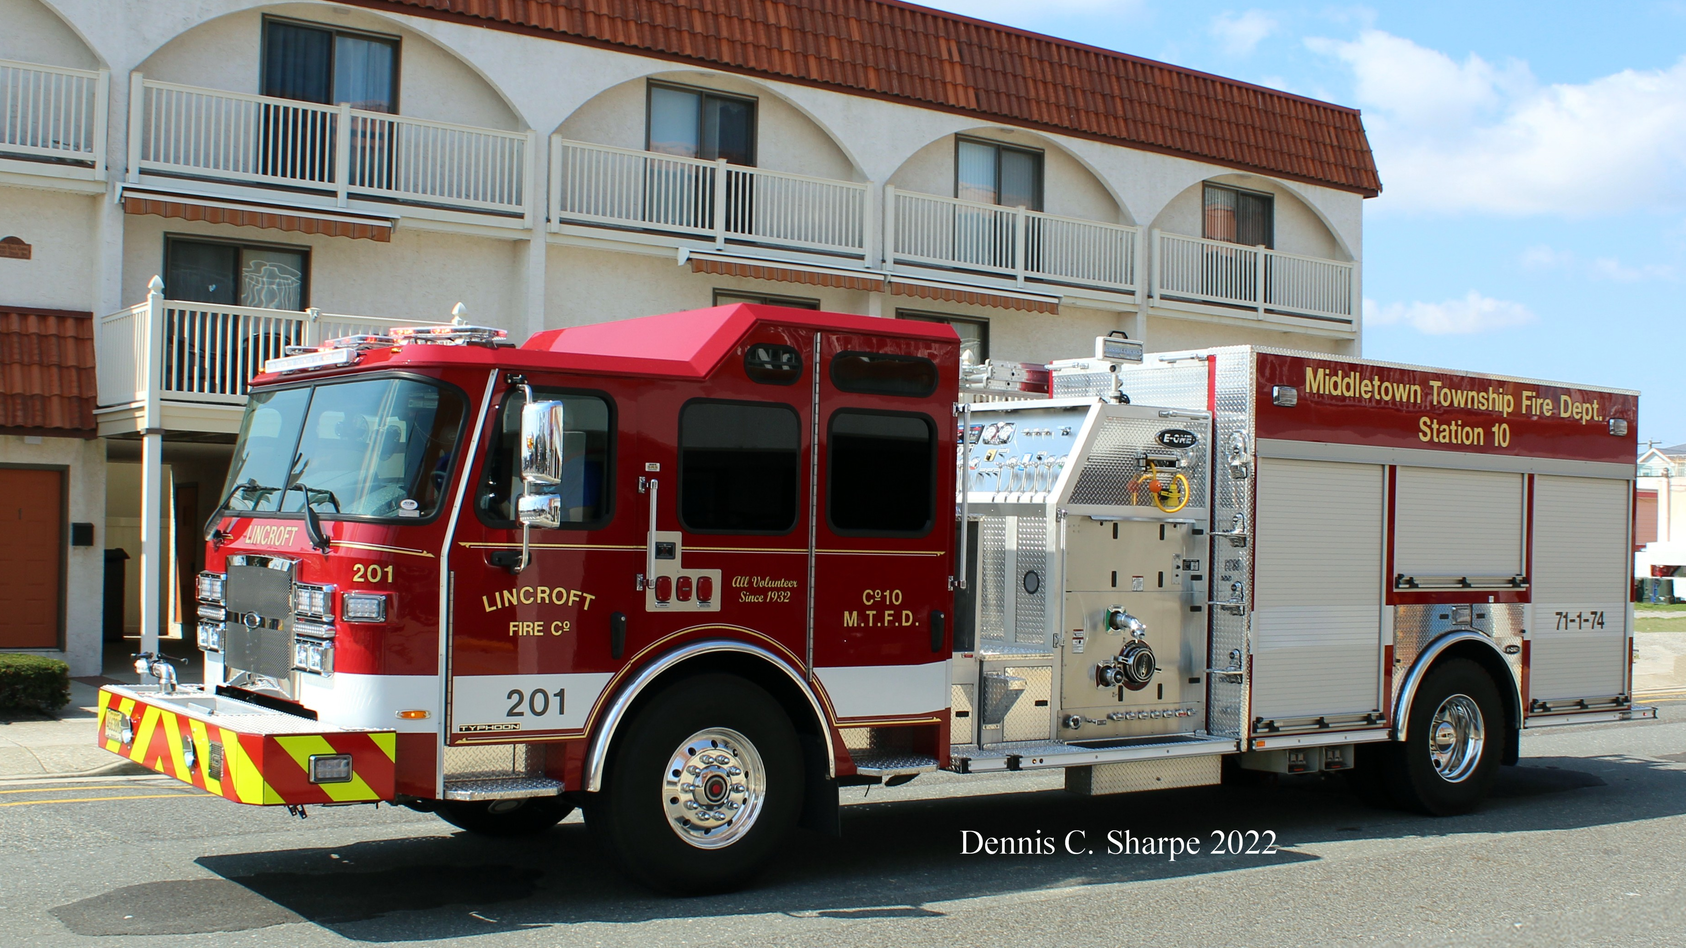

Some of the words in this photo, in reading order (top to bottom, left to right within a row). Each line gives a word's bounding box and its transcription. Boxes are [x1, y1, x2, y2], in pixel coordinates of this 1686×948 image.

[1304, 366, 1421, 404] Middletown
[1428, 380, 1515, 418] Township
[1520, 391, 1553, 417] Fire
[1559, 395, 1604, 425] Dept.
[1163, 433, 1193, 444] E-ONE
[1418, 416, 1485, 446] Station
[1491, 422, 1511, 448] 10
[245, 525, 298, 546] LINCROFT
[352, 564, 394, 583] 201
[732, 575, 750, 588] All
[751, 575, 798, 588] Volunteer
[482, 586, 596, 613] LINCROFT
[738, 590, 764, 603] Since
[766, 591, 791, 603] 1932
[509, 621, 544, 637] FIRE
[1555, 611, 1604, 630] 71-1-74
[506, 688, 566, 718] 201
[459, 724, 520, 732] TYPHOON
